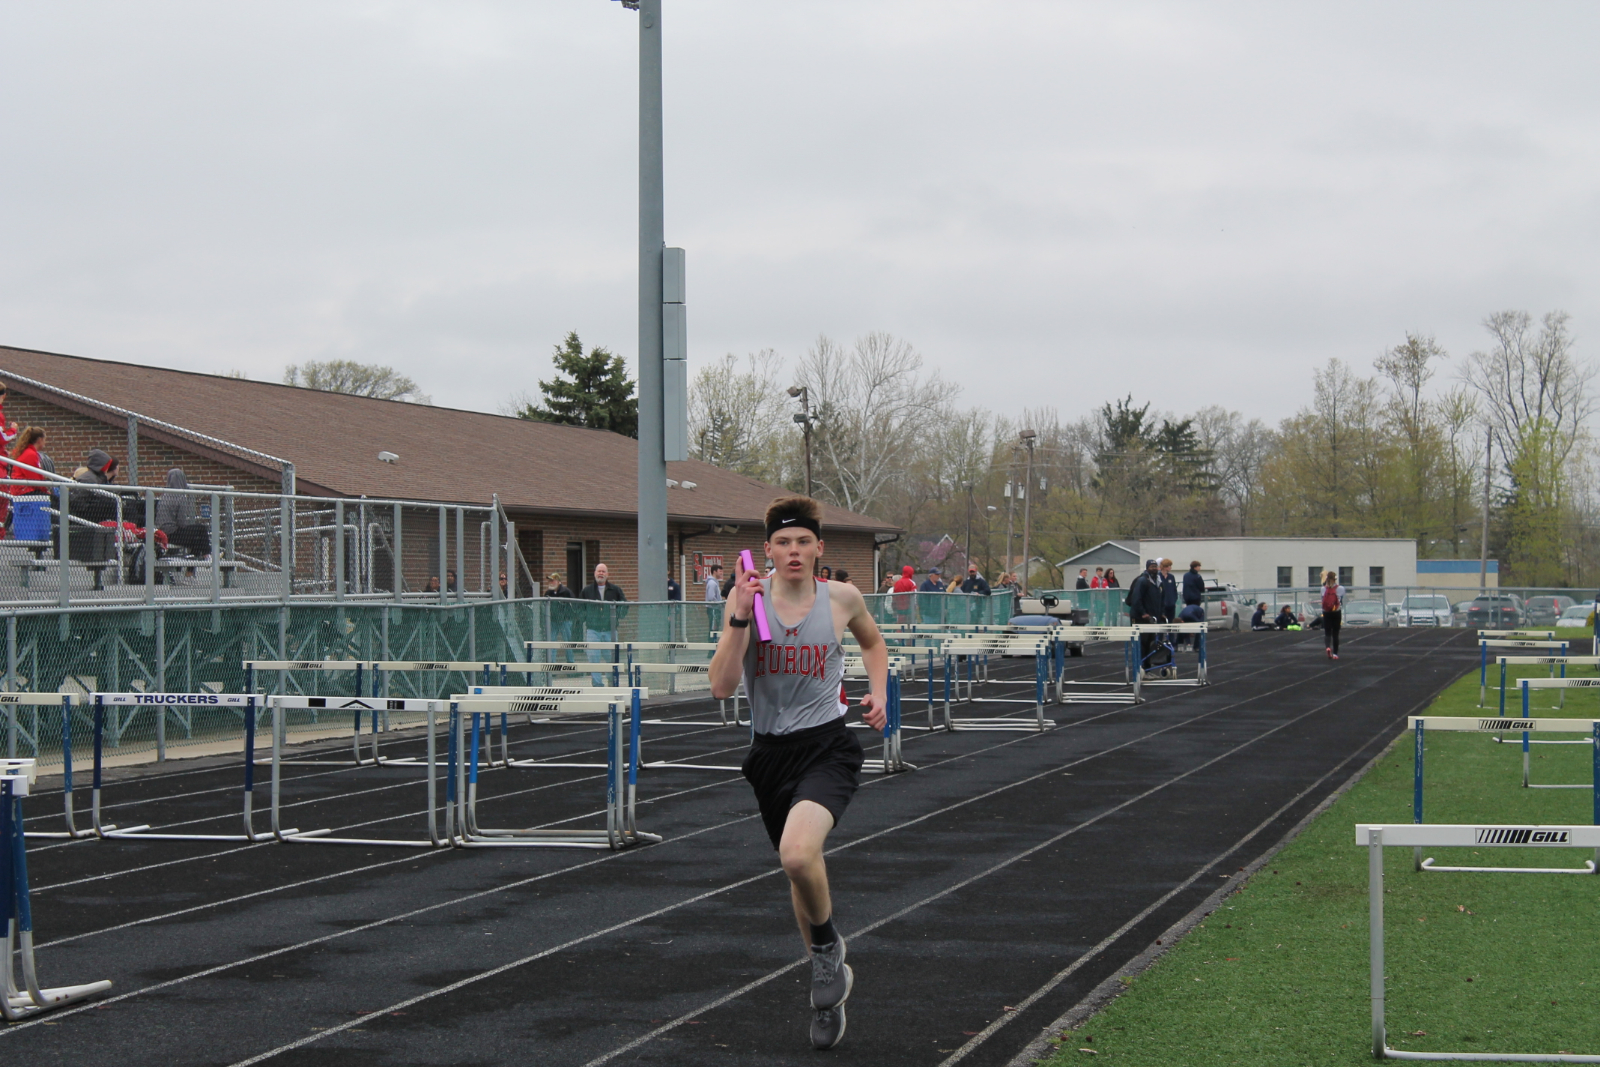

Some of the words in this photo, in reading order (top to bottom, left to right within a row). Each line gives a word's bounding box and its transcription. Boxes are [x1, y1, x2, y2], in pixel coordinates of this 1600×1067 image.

[755, 641, 828, 682] HURON
[134, 695, 219, 704] TRUCKERS
[1531, 831, 1568, 843] GILL
